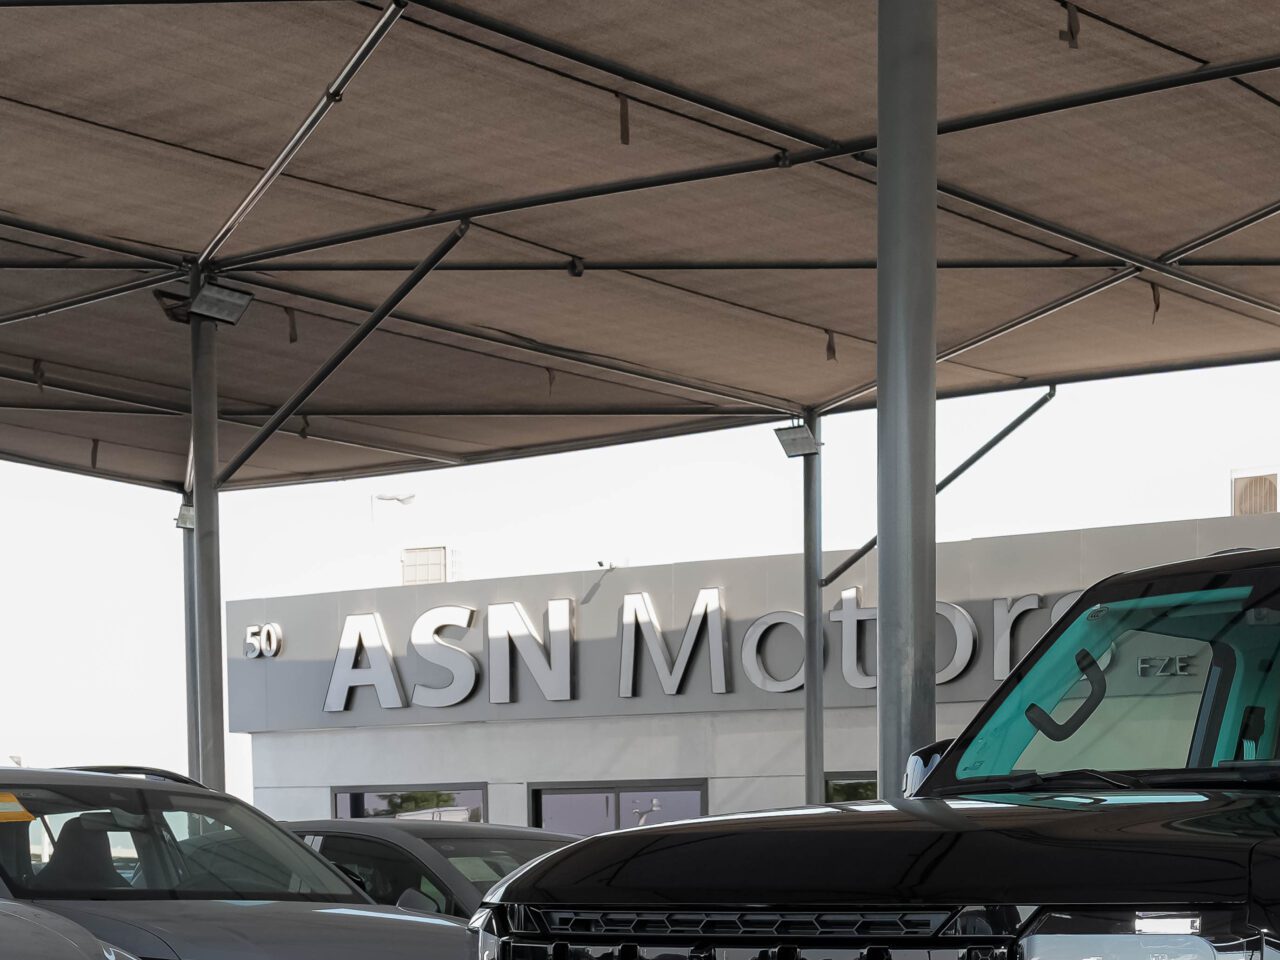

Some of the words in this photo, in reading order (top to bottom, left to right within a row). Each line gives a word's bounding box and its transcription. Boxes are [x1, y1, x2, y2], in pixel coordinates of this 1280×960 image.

[245, 622, 283, 658] 50
[322, 598, 577, 712] ASN
[1136, 655, 1191, 677] FZE
